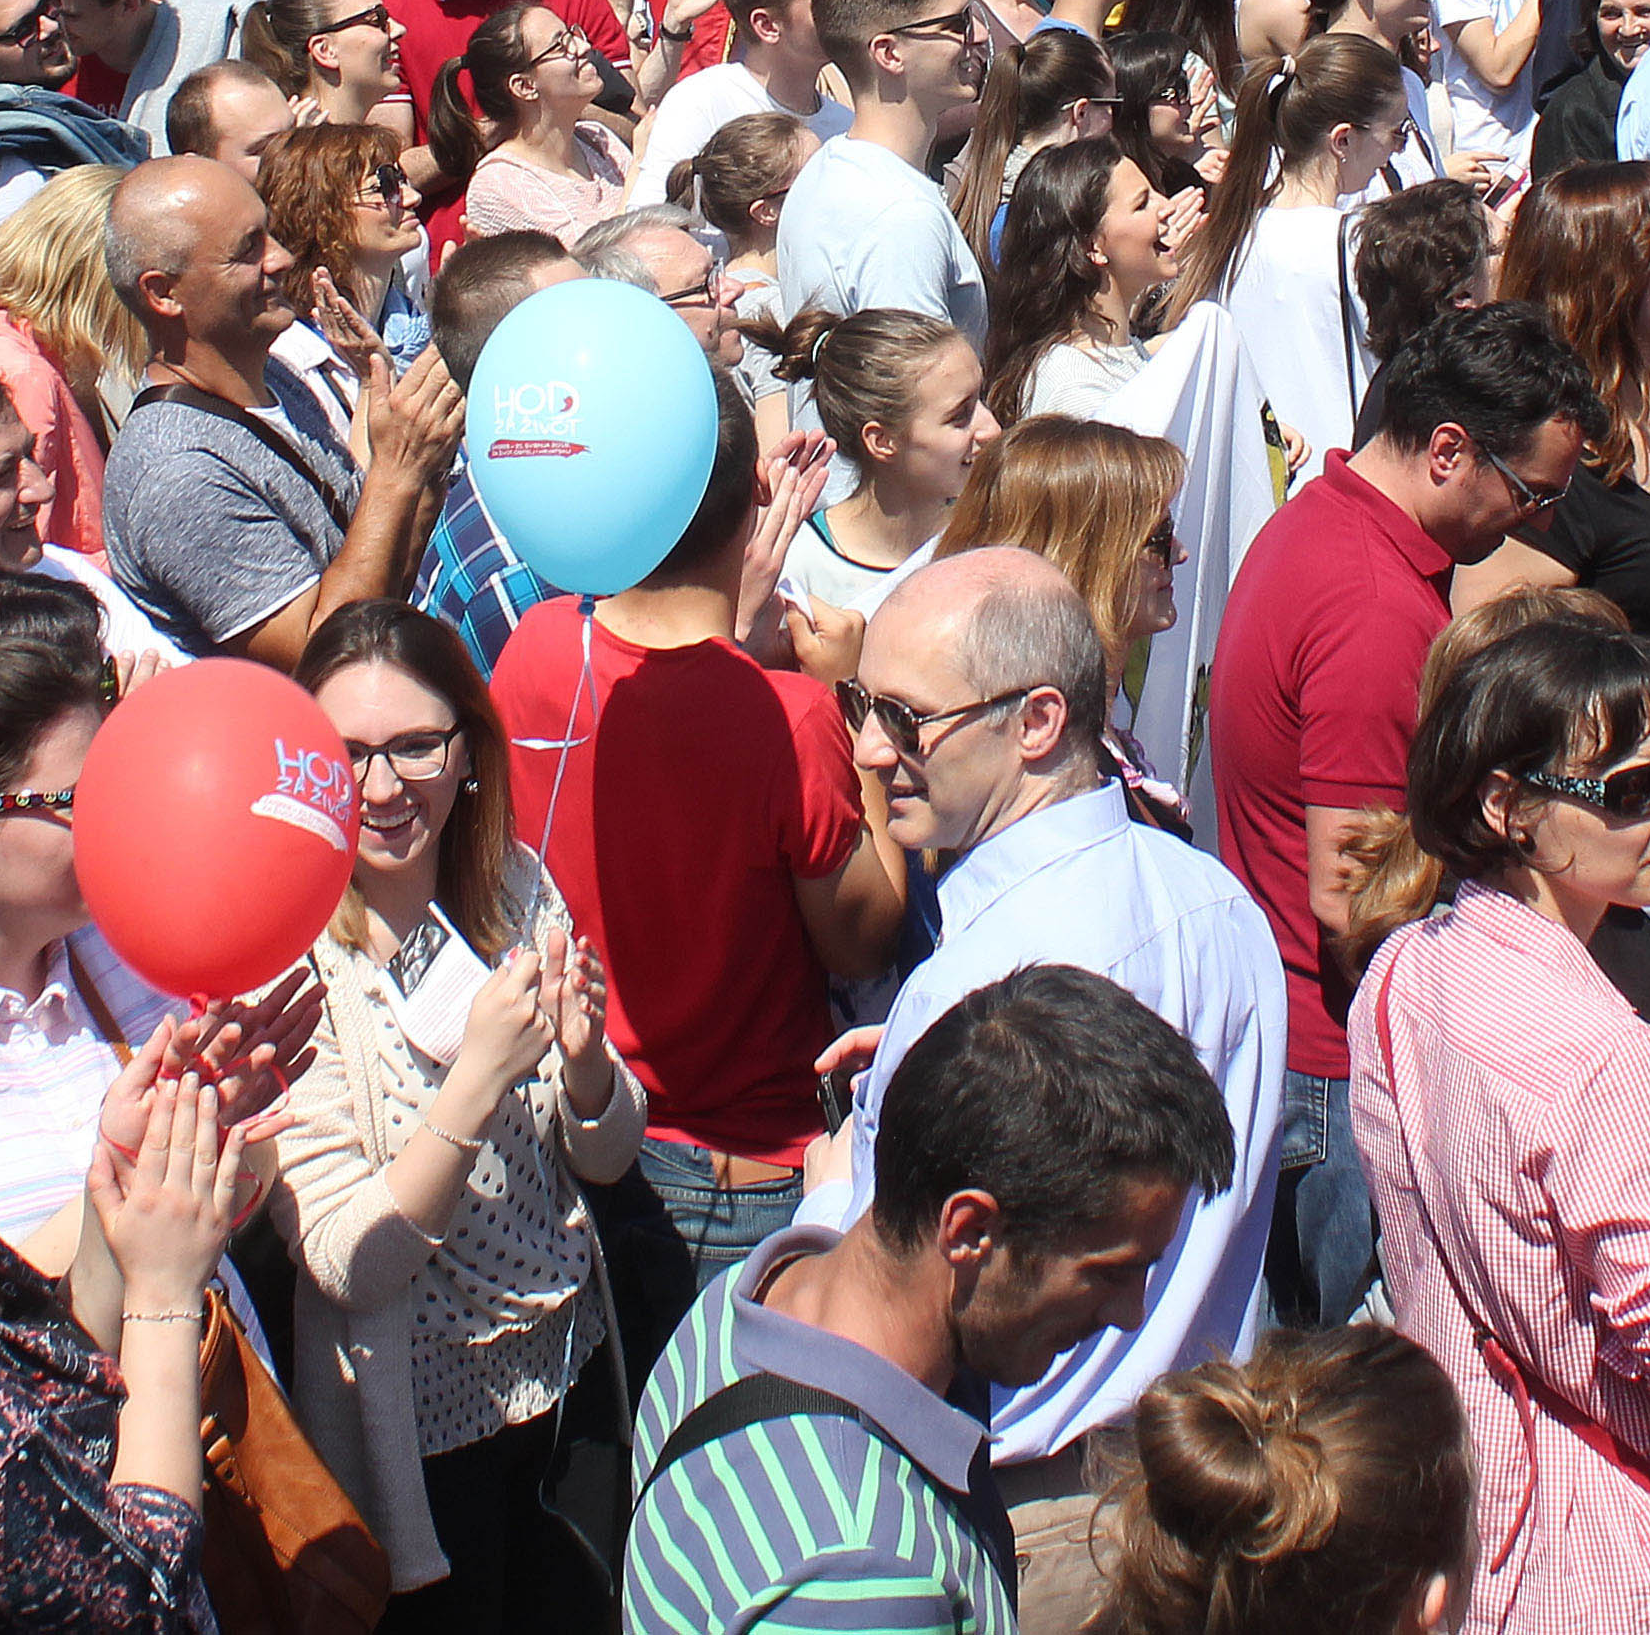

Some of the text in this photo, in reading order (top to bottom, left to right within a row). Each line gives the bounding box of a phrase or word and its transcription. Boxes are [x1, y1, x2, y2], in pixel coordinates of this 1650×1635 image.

[493, 381, 580, 421] HOD
[493, 414, 585, 437] ZA ŽIVOT
[274, 737, 353, 807] HOD
